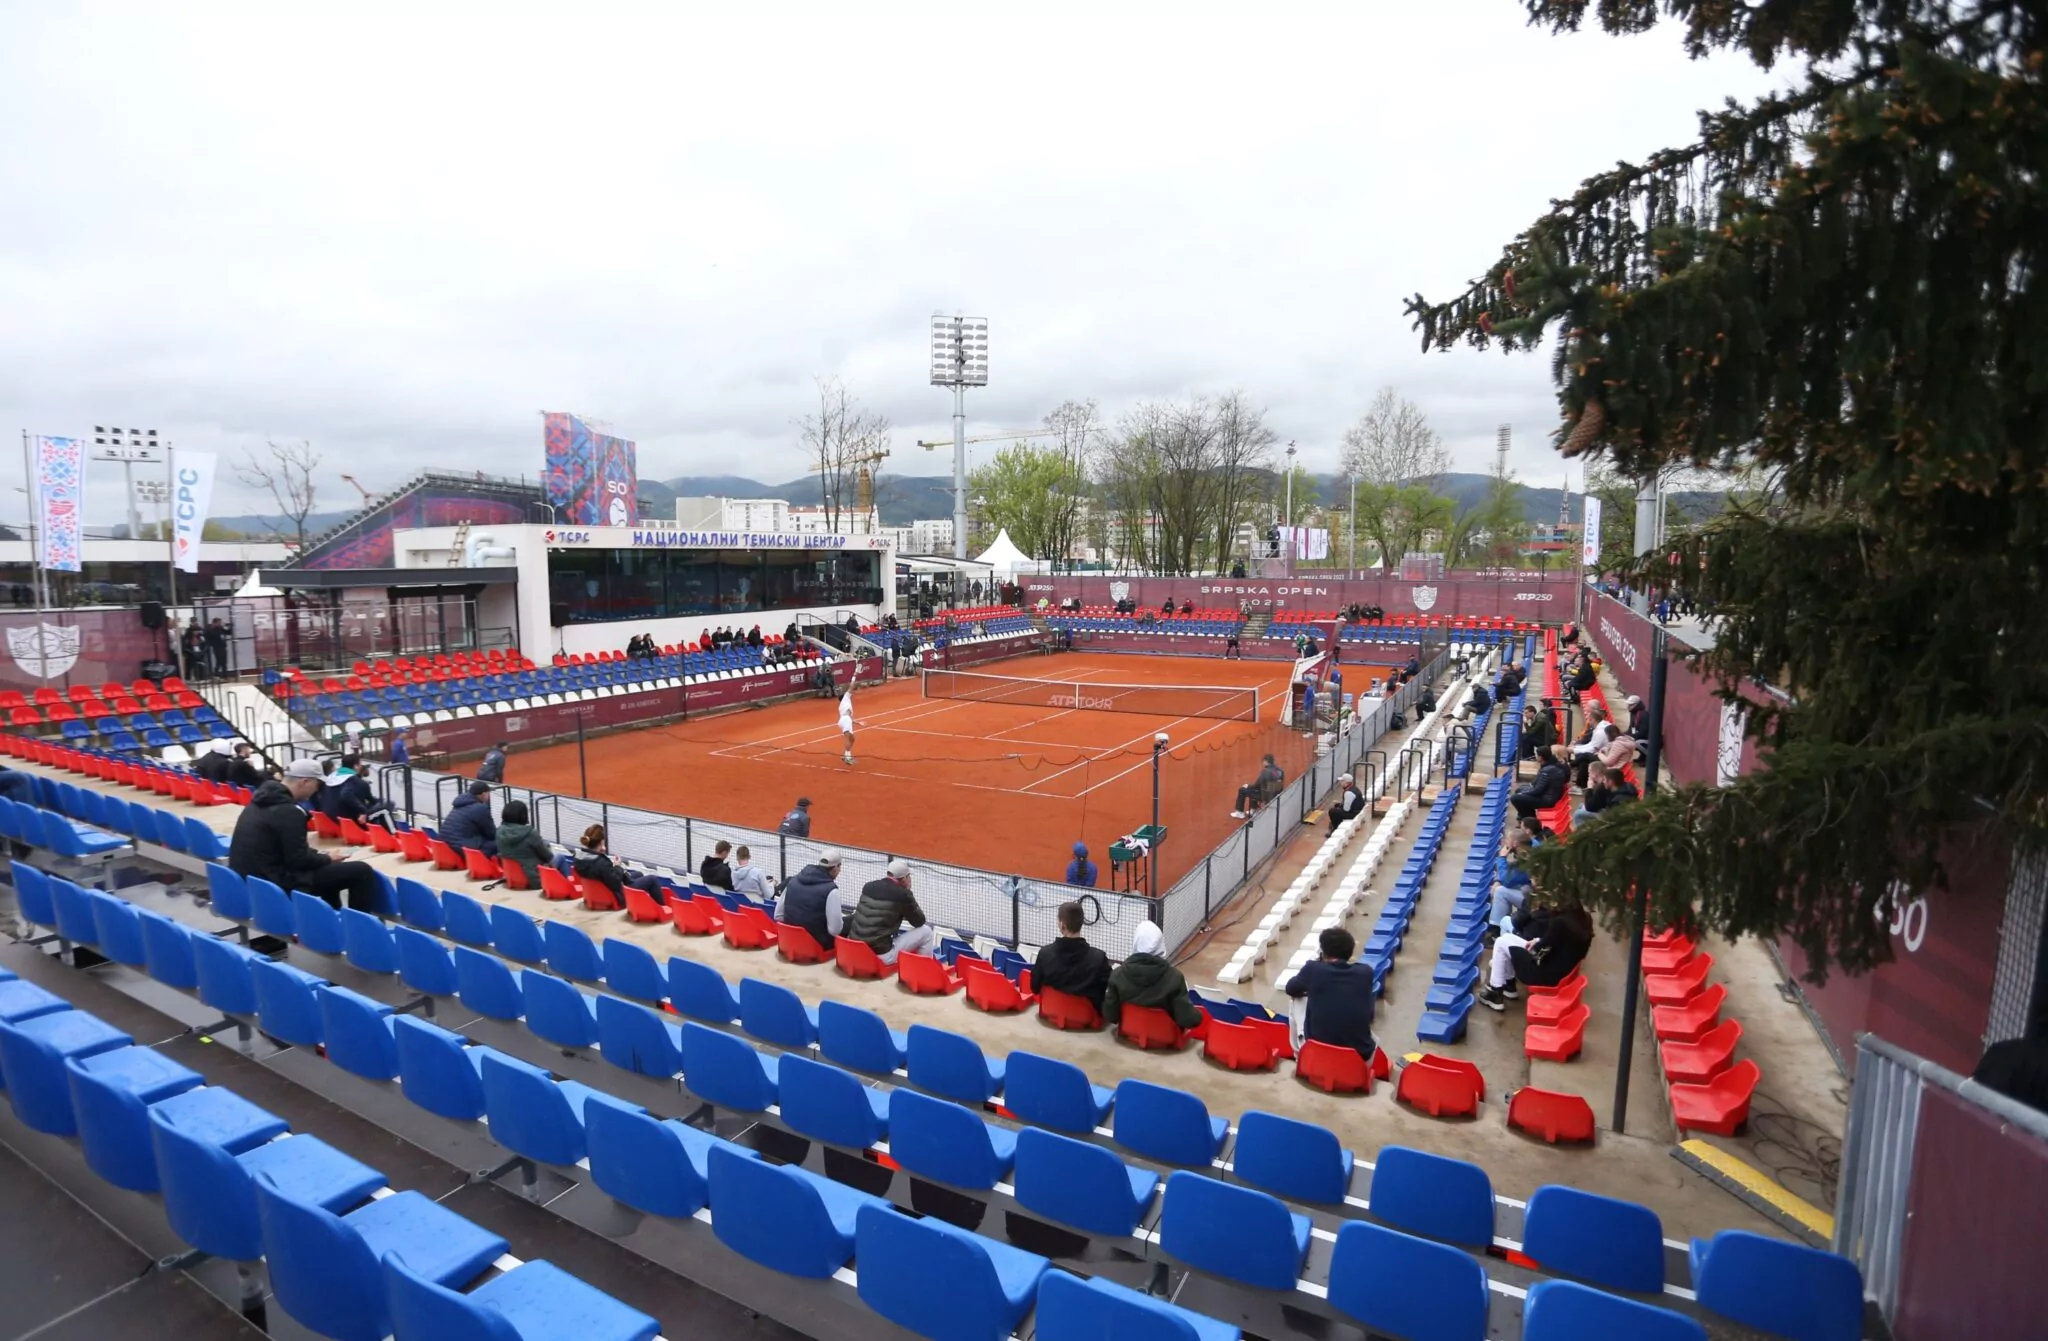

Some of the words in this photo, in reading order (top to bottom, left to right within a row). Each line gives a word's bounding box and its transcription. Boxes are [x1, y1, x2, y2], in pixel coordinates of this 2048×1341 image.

[608, 481, 627, 495] SO
[633, 531, 738, 548] НАЦИОНАЛНИ
[743, 534, 800, 547] ТЕНИСКИ
[804, 536, 846, 549] ЦЕНТАР
[1201, 586, 1269, 594] SRPSKA
[1277, 587, 1327, 595] OPEN
[1240, 598, 1285, 606] 2023
[1047, 694, 1076, 706] ATP
[1078, 696, 1113, 709] TOUR
